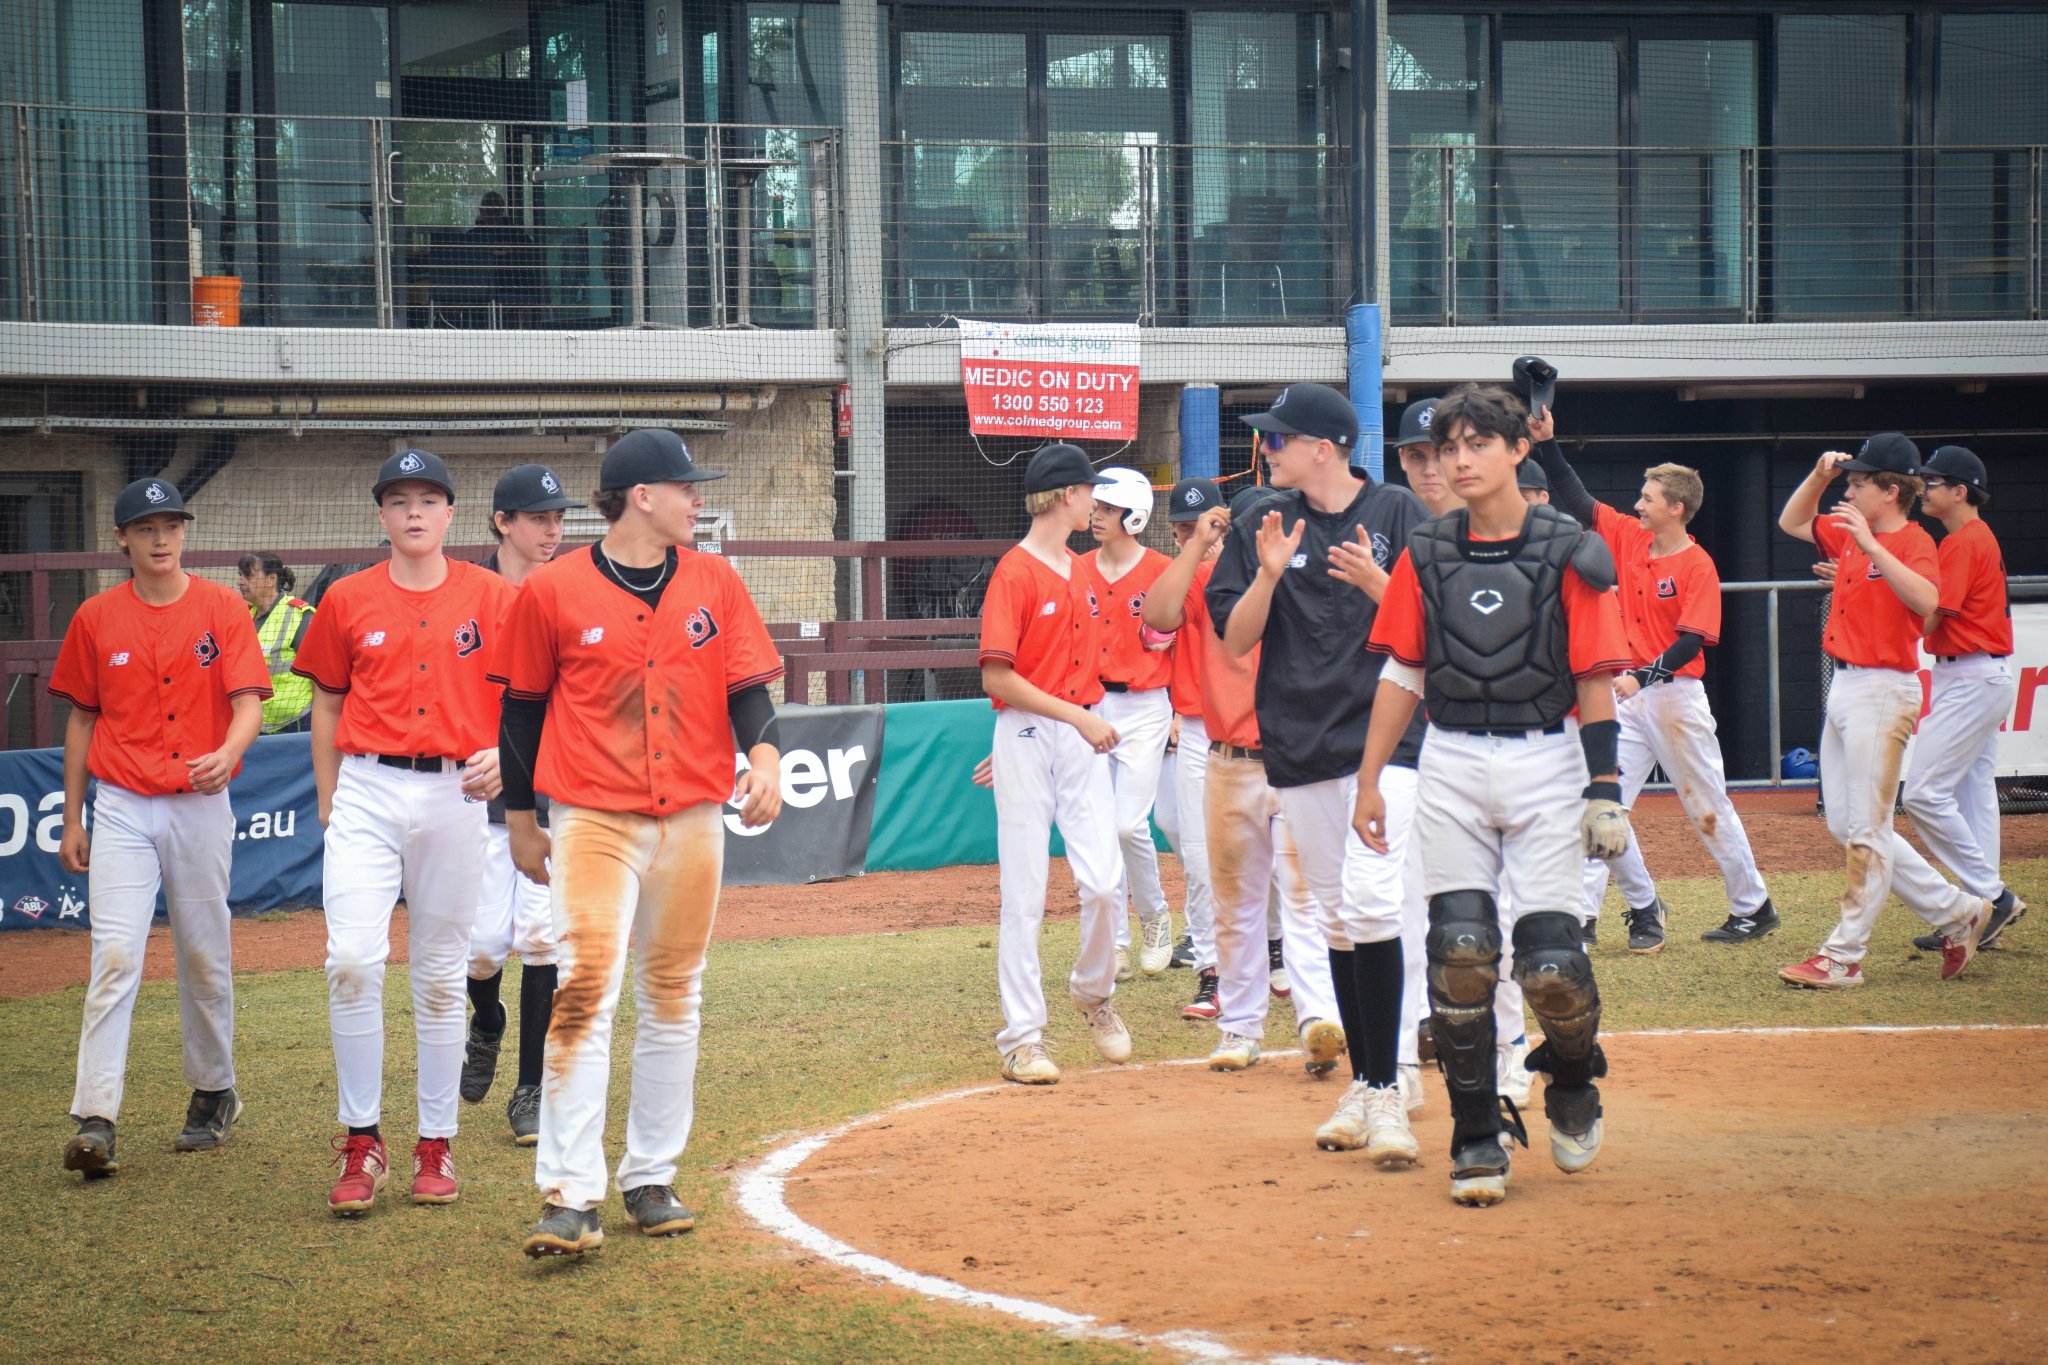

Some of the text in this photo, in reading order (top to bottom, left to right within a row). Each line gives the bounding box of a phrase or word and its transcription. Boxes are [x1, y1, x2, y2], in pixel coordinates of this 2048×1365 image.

[1015, 333, 1112, 353] colmed group
[965, 366, 1133, 392] MEDIC ON DUTY
[992, 394, 1104, 414] 1300 550 123
[974, 414, 1122, 431] www.colmedgroup.com
[232, 810, 296, 840] .au
